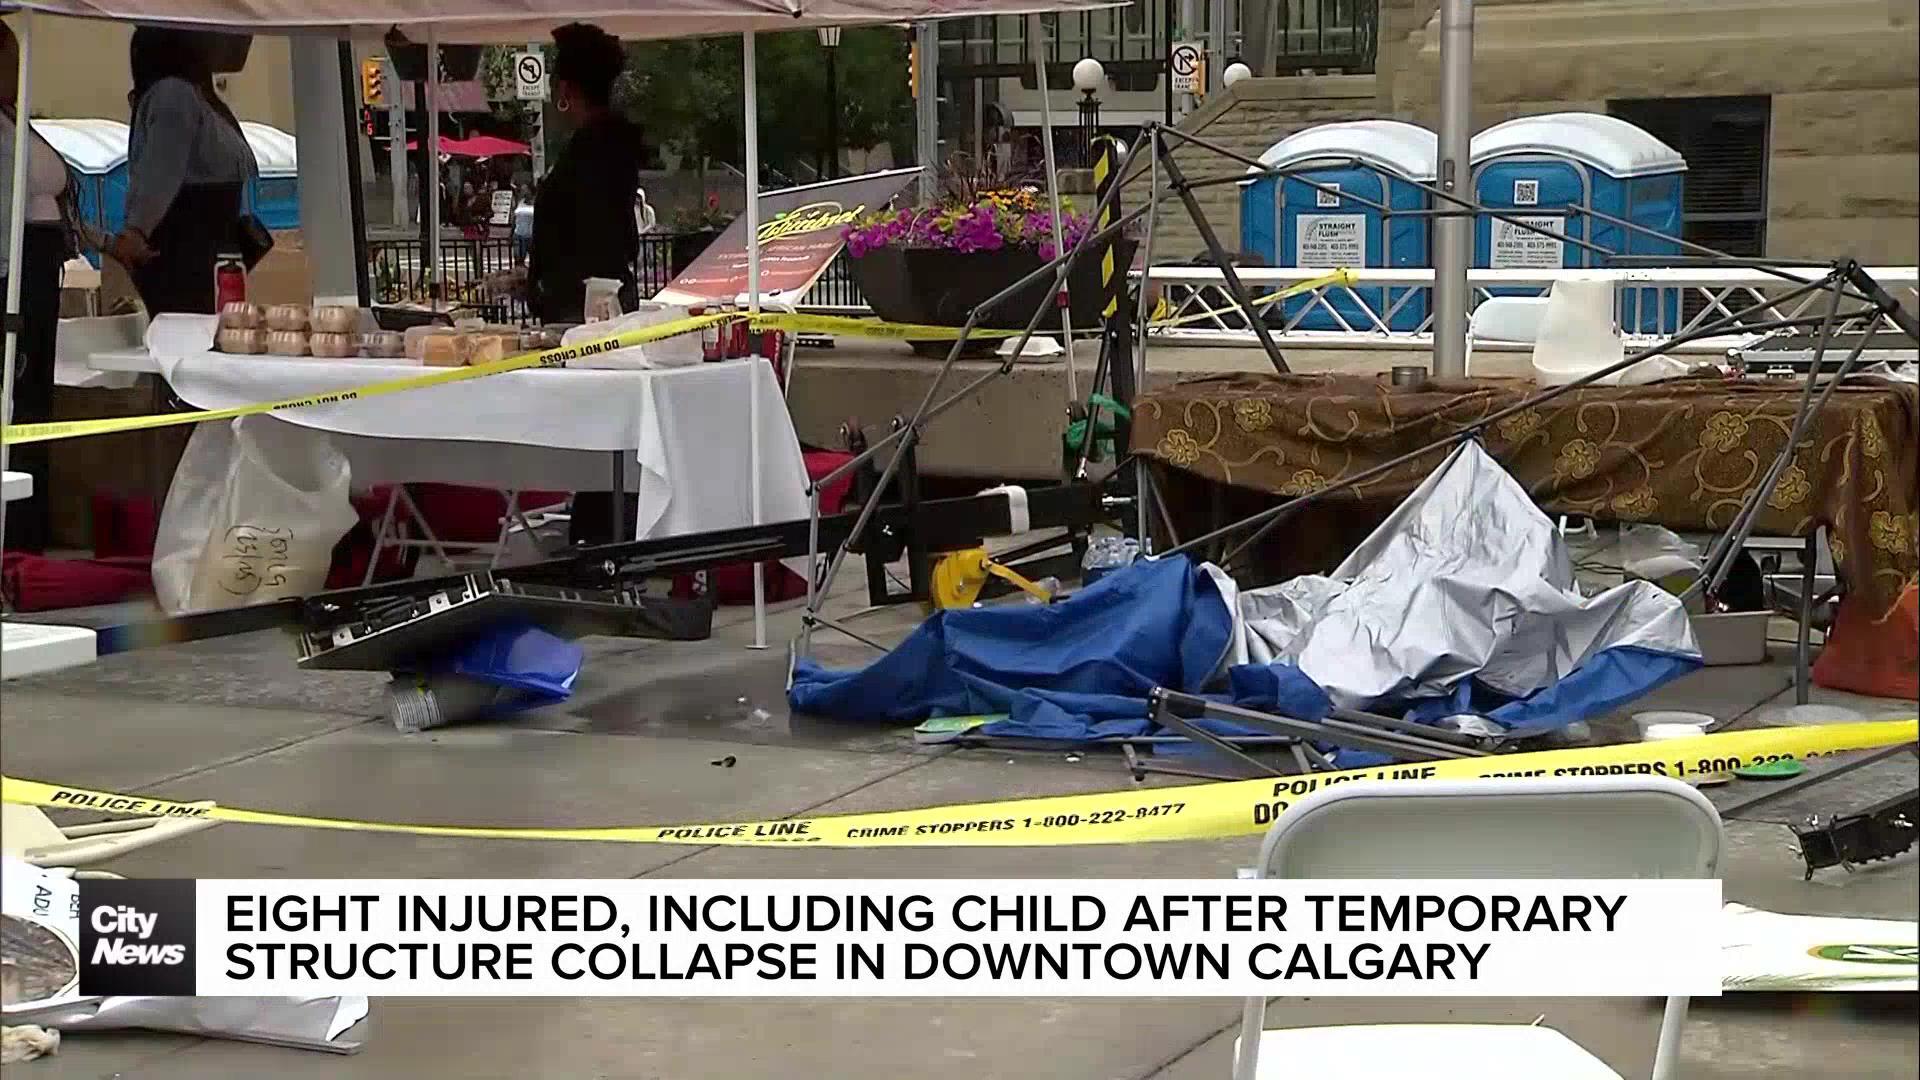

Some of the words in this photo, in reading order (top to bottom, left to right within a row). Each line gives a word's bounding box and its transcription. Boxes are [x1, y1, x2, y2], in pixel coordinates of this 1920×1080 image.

[1318, 230, 1338, 238] FLUSH
[579, 343, 602, 358] NOT
[604, 338, 620, 352] DO
[540, 350, 577, 365] CROSS
[51, 791, 147, 811] POLICE
[847, 825, 910, 839] CRIME
[916, 818, 1015, 836] STOPPERS
[1023, 803, 1186, 829] 1-800-222-8477
[657, 825, 748, 839] POLICE
[754, 821, 812, 837] LINE
